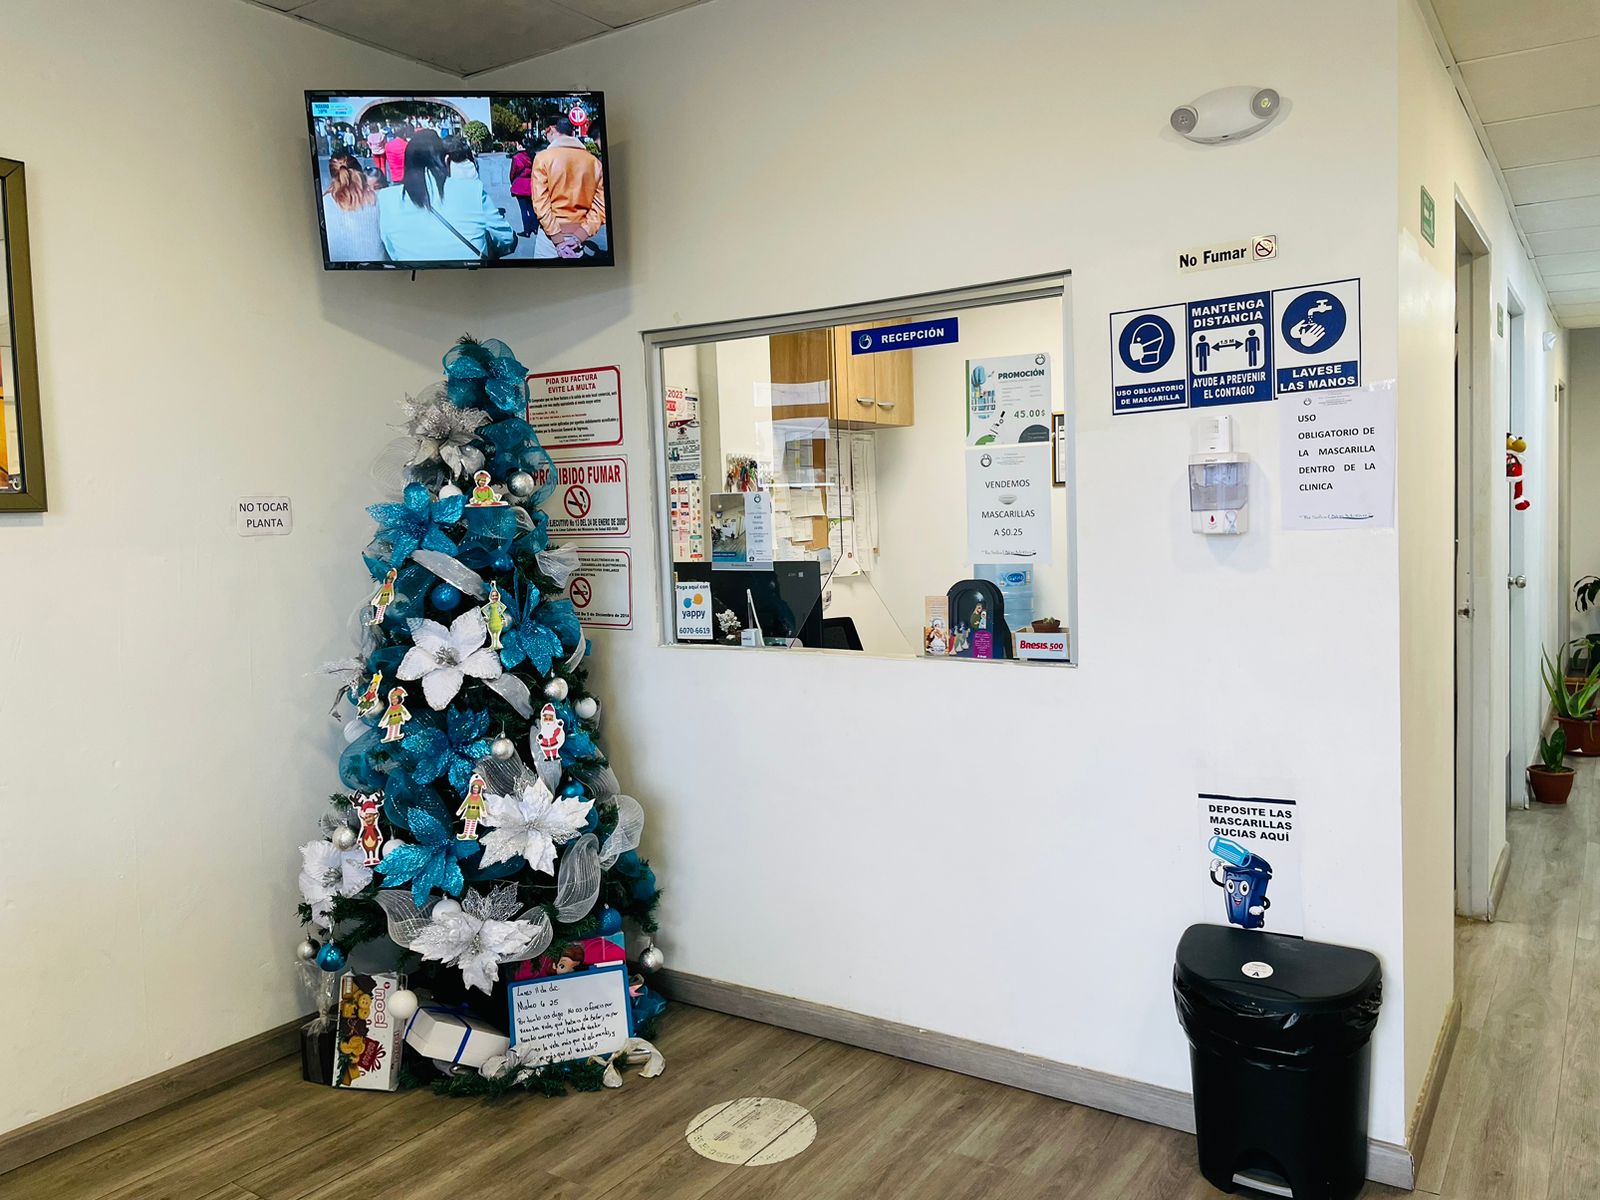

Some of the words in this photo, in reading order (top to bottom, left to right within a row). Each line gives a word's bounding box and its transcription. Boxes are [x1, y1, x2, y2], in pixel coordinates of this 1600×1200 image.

[1179, 254, 1197, 268] No
[1203, 247, 1247, 264] Fumar
[1191, 299, 1265, 317] MANTENGA
[1193, 311, 1263, 328] DISTANCIA
[881, 327, 945, 344] RECEPCIÓN
[998, 368, 1045, 380] PROMOCIÓN
[1292, 364, 1342, 378] LAVESE
[560, 376, 569, 384] SU
[570, 373, 598, 383] FACTURA
[1192, 376, 1218, 388] AYUDE
[1219, 375, 1226, 386] A
[1226, 371, 1266, 385] PREVENIR
[1280, 381, 1304, 392] LAS
[1308, 376, 1355, 389] MANOS
[548, 386, 566, 394] EVITE
[566, 384, 575, 392] LA
[575, 382, 596, 391] MULTA
[667, 389, 683, 399] 2023
[1116, 389, 1132, 397] USO
[1133, 384, 1184, 395] OBLIGATORIO
[1203, 389, 1214, 399] EL
[1214, 385, 1255, 398] CONTAGIO
[1132, 393, 1180, 404] MASCARILLA
[1014, 409, 1046, 419] 45.00$
[1297, 414, 1317, 423] USO
[1298, 428, 1359, 440] OBLIGATORIO
[1363, 427, 1375, 435] DE
[1298, 449, 1309, 457] LA
[1318, 445, 1376, 456] MASCARILLA
[1298, 464, 1335, 475] DENTRO
[1344, 463, 1356, 472] DE
[1364, 462, 1376, 471] LA
[533, 467, 585, 487] PROIBIDO
[587, 465, 621, 484] FUMAR
[984, 479, 1031, 489] VENDEMOS
[1299, 482, 1333, 491] CLINICA
[239, 502, 255, 512] NO
[256, 502, 289, 512] TOCAR
[981, 509, 1036, 519] MASCARILLAS
[246, 518, 284, 528] PLANTA
[993, 528, 1000, 537] A
[1001, 527, 1023, 537] $0.25
[681, 610, 706, 620] yappy
[679, 627, 711, 635] 6070-6619
[1049, 642, 1064, 650] 500
[1208, 804, 1266, 817] DEPOSITE
[1269, 809, 1292, 819] LAS
[1210, 816, 1292, 830] MASCARILLAS
[1213, 827, 1256, 839] SUCIAS
[1260, 831, 1289, 842] AQUÍ
[374, 988, 388, 1029] noel
